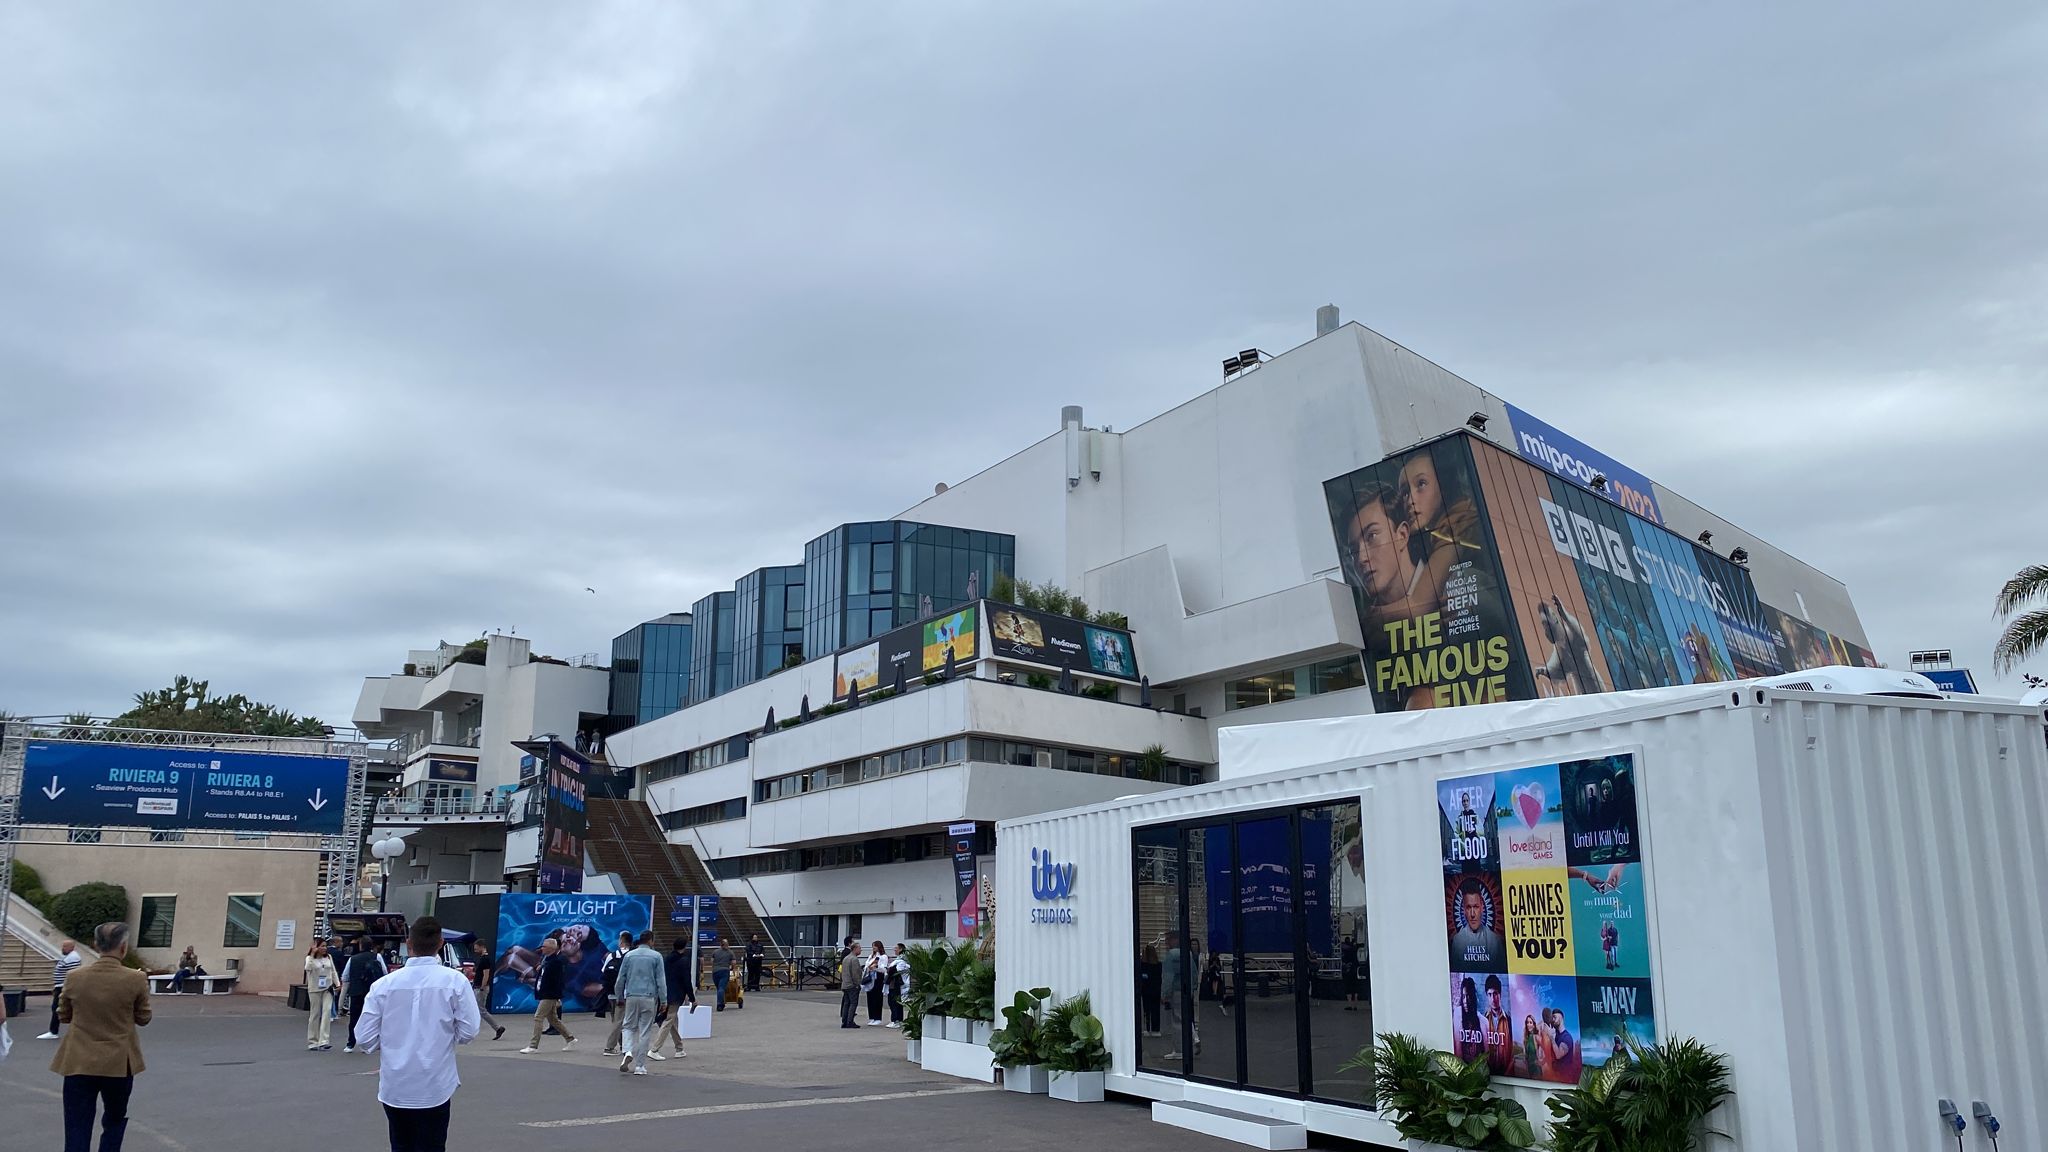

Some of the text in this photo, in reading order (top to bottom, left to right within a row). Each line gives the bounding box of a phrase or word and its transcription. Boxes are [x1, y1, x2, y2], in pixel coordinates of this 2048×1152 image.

[1614, 480, 1659, 523] 2023
[1546, 507, 1730, 617] BBC STUDIOS
[1447, 584, 1478, 597] WINDING
[1447, 593, 1478, 612] REFN
[1449, 615, 1479, 628] MOONAGE
[1449, 622, 1480, 636] PICTURES
[1384, 611, 1442, 654] THE
[1376, 636, 1510, 693] FAMOUS
[1434, 674, 1506, 708] FIVE
[169, 760, 196, 769] Access
[108, 768, 179, 784] RIVIERA 9
[207, 773, 274, 788] RIVIERA 8
[95, 784, 178, 794] Seaview Producers Hub
[234, 789, 255, 797] R8.A4
[238, 812, 258, 820] PALAIS
[1460, 814, 1478, 832] THE
[1573, 829, 1630, 849] Until I Kill You
[1452, 836, 1488, 860] FLOOD
[1533, 851, 1553, 860] GAMES
[1031, 847, 1073, 900] itv
[534, 900, 617, 915] DAYLIGHT
[1508, 882, 1565, 916] CANNES
[1584, 900, 1594, 909] my
[1031, 908, 1072, 924] STUDIOS
[1600, 903, 1632, 921] your dad
[1511, 917, 1565, 937] WE TEMPT
[1464, 953, 1490, 962] KITCHEN
[1466, 945, 1486, 953] HELL'S
[1512, 938, 1568, 960] YOU?
[1592, 986, 1637, 1015] THE WAY
[1459, 1029, 1506, 1046] DEAD HOT
